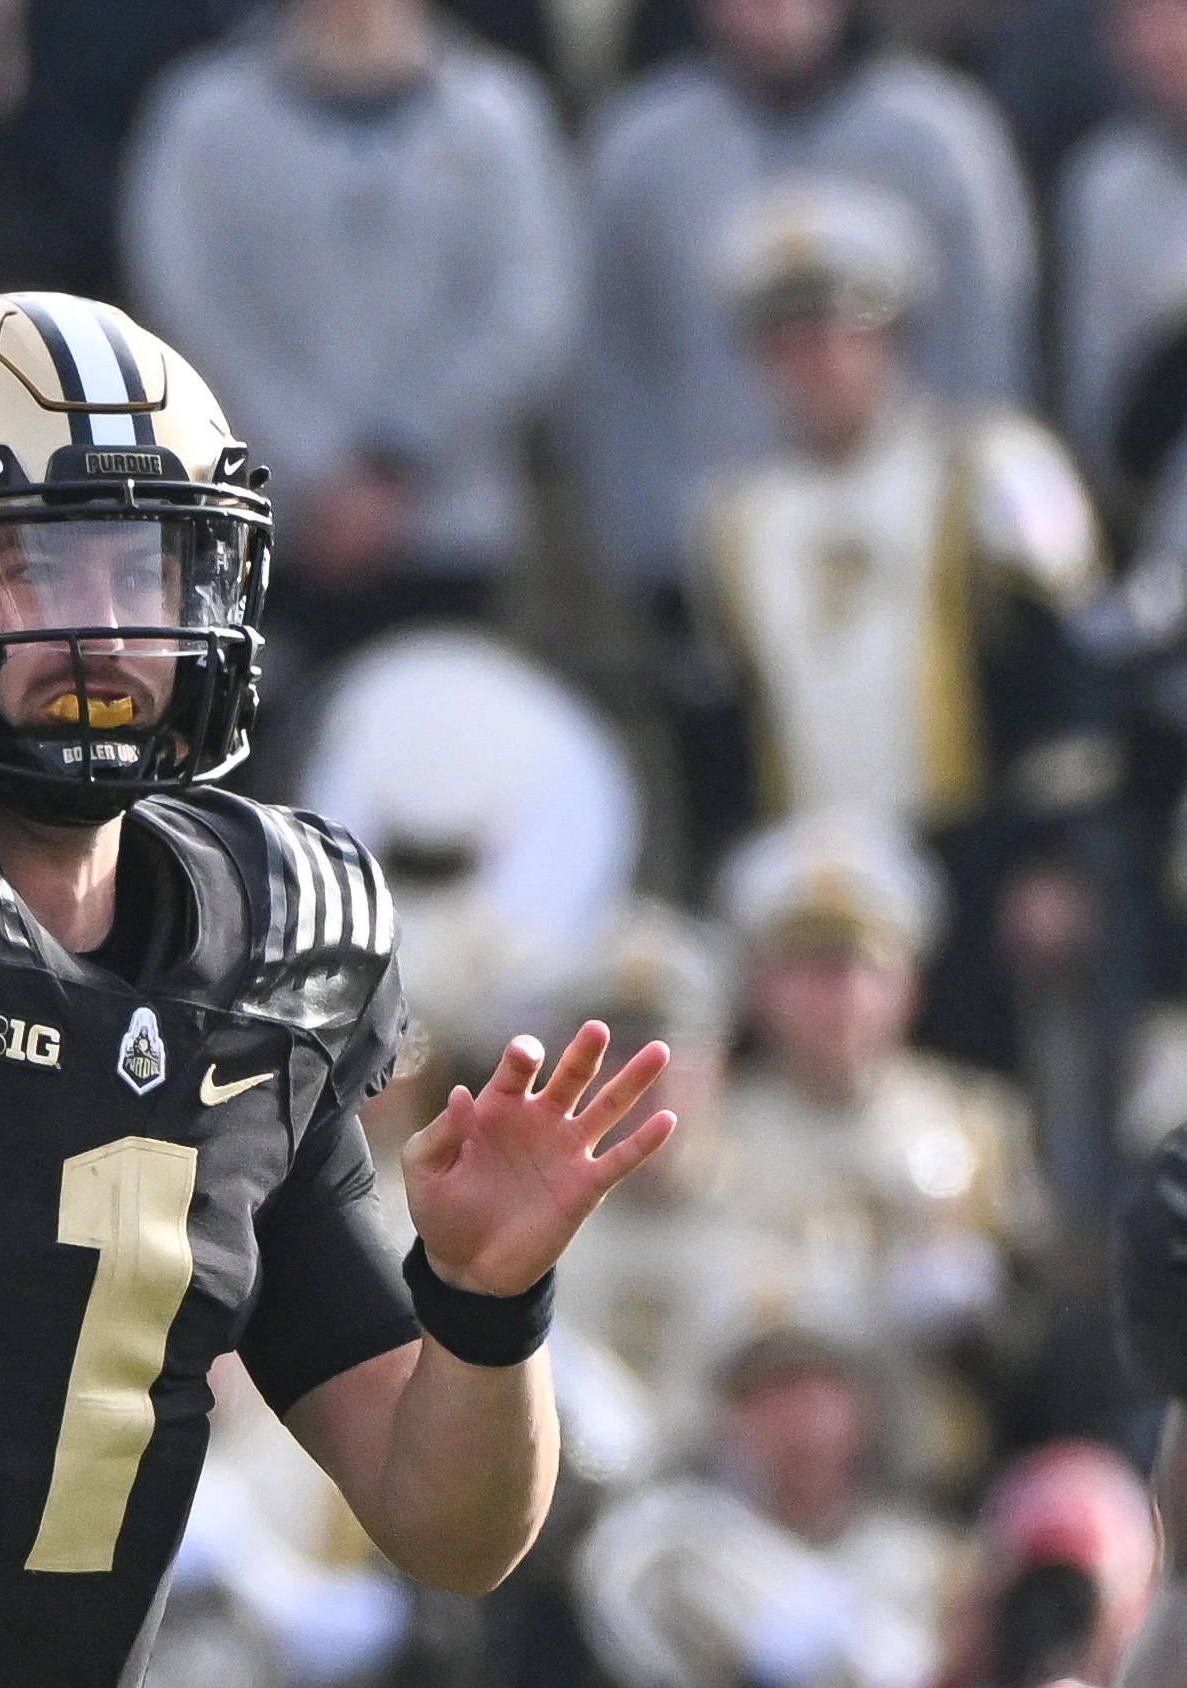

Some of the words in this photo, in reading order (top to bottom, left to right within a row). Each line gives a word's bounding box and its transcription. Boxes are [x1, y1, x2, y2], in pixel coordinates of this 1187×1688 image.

[85, 453, 162, 475] PURDUE
[62, 744, 115, 764] BOLER
[24, 1136, 199, 1574] 1
